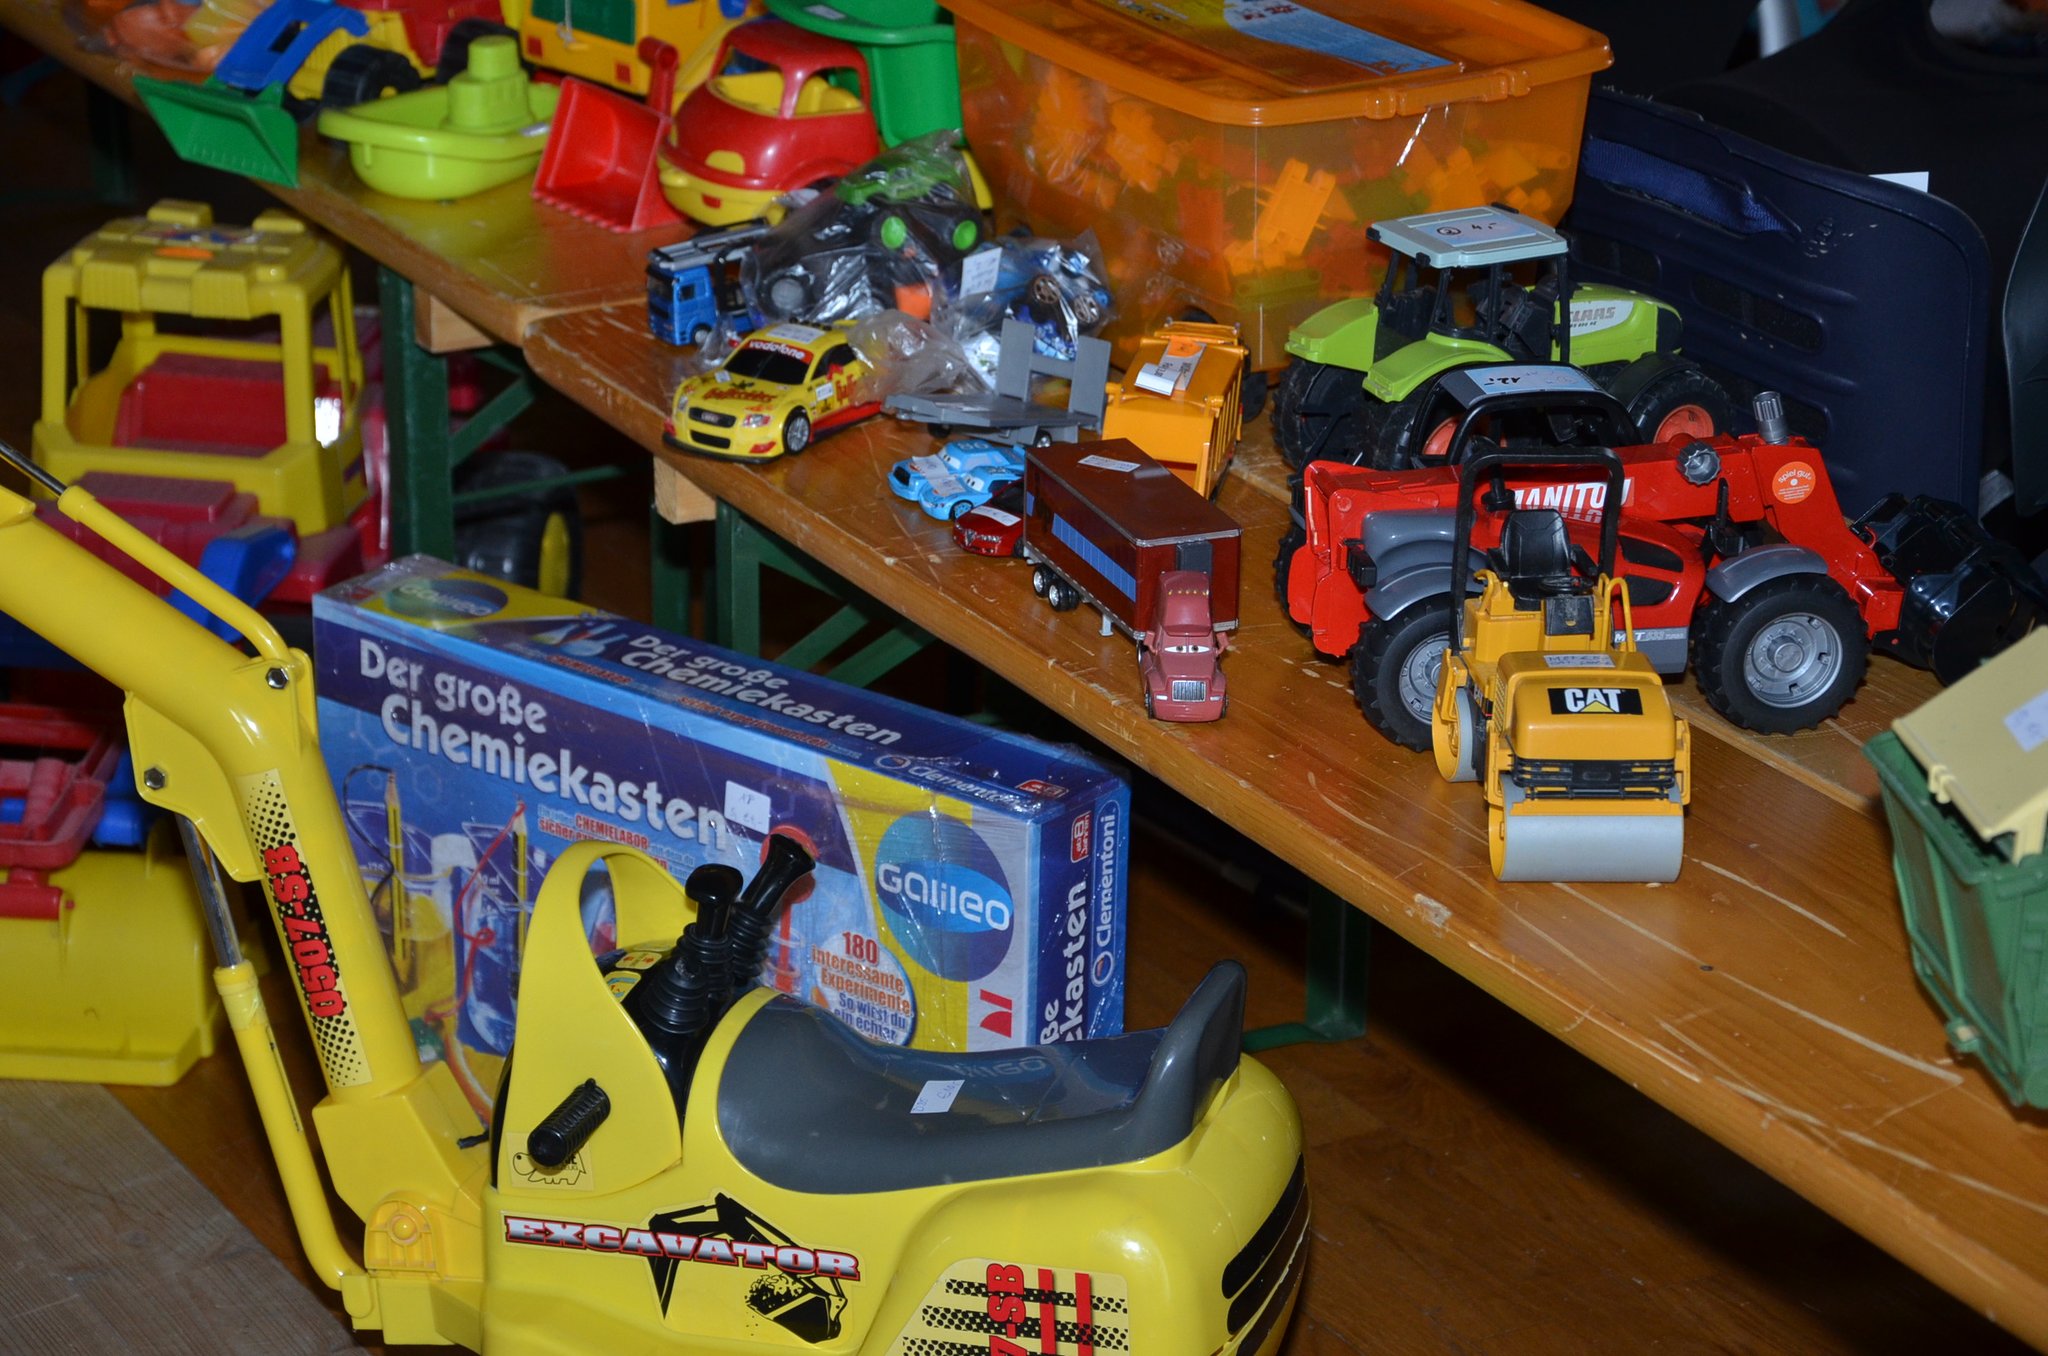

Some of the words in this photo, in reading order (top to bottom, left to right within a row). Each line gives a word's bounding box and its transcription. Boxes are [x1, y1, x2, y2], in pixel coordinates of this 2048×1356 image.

[1570, 306, 1616, 322] LAAS
[750, 339, 806, 360] vodafone
[1614, 631, 1646, 643] MT
[630, 634, 688, 662] Der
[685, 652, 790, 690] große
[359, 637, 424, 692] Der
[434, 668, 549, 734] große
[620, 650, 903, 746] Chemiekasten
[1563, 687, 1622, 713] CAT
[380, 693, 732, 852] Chemiekasten
[907, 765, 1023, 806] Clemento
[538, 817, 574, 841] sicher
[575, 813, 649, 850] CHEMIELABOR
[877, 862, 1011, 932] Galileo
[1096, 813, 1116, 947] Clementoni
[263, 844, 347, 1018] 0507-SB
[842, 931, 879, 966] 180
[820, 967, 911, 1018] Experimente
[839, 992, 855, 1012] So
[890, 1010, 906, 1029] du
[503, 1215, 861, 1282] EXCAVATOR
